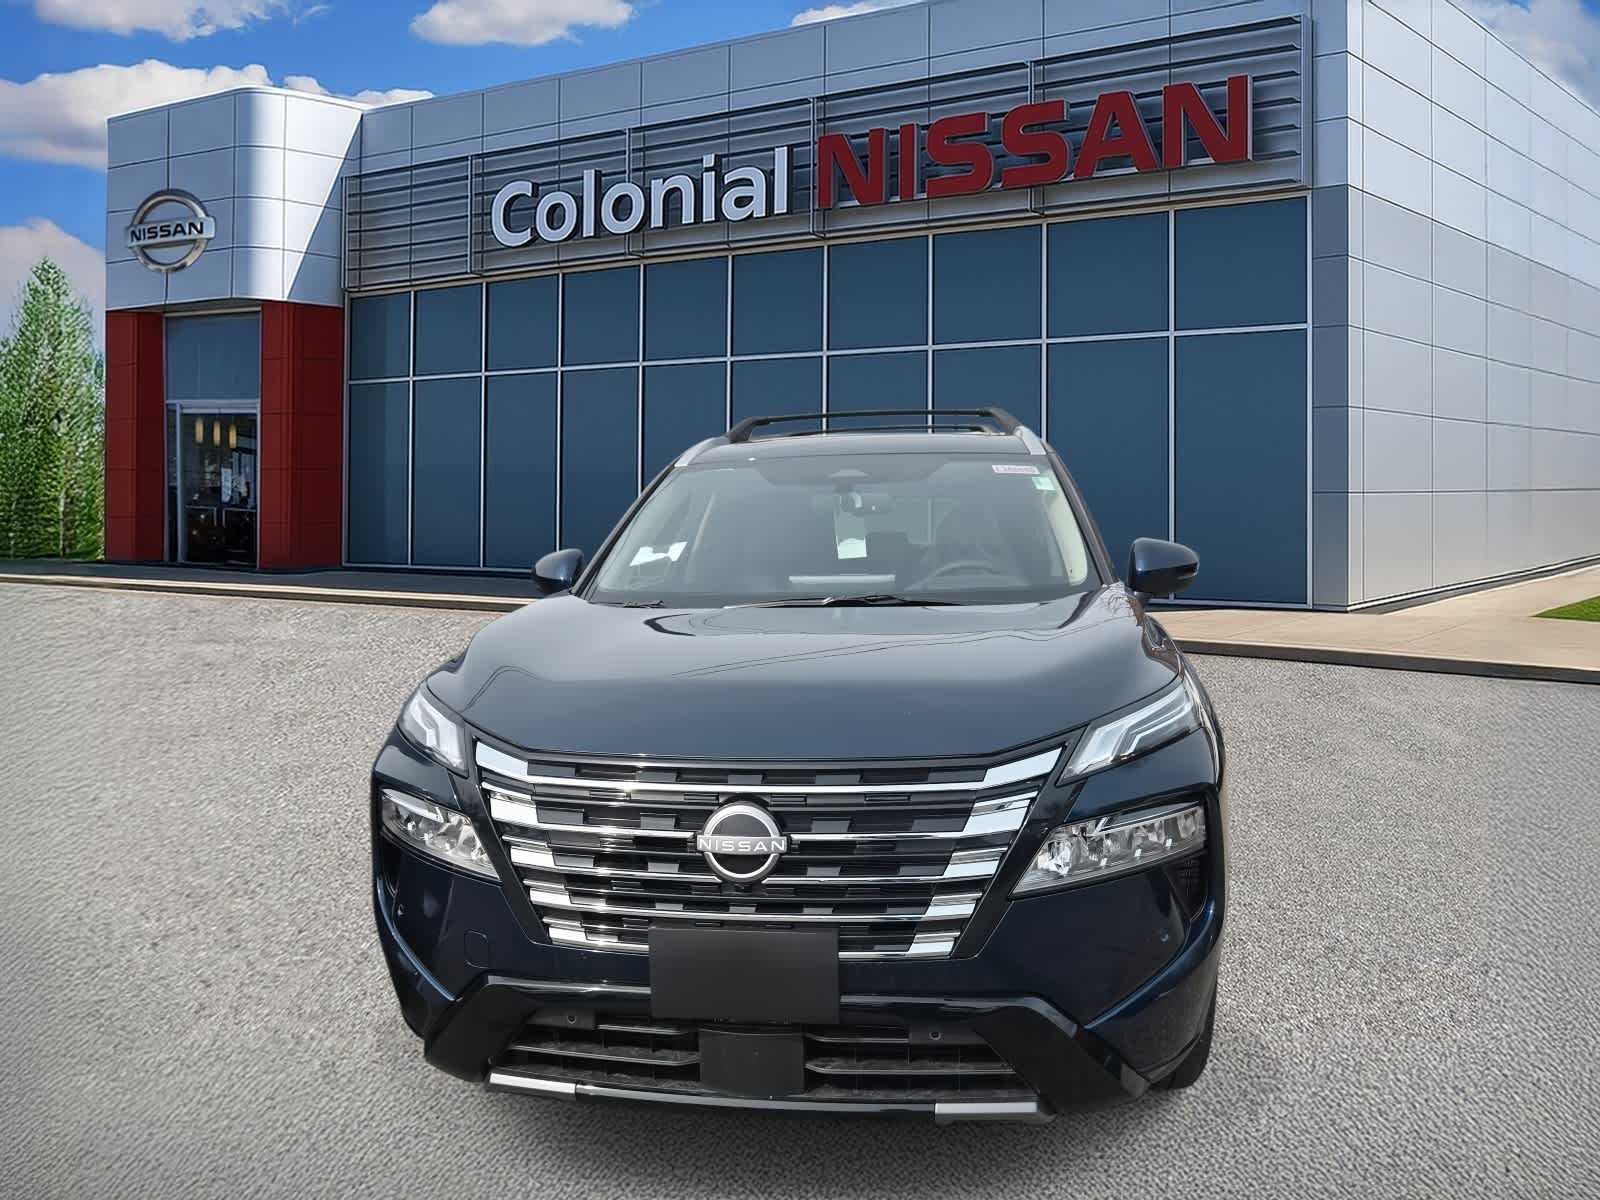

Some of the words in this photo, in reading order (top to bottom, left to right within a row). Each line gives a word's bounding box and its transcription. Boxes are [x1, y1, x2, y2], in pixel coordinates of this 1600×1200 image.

[490, 146, 790, 248] Colonial
[817, 74, 1254, 209] NISSAN
[130, 221, 204, 242] NISSAN
[699, 838, 785, 852] NISSAN
